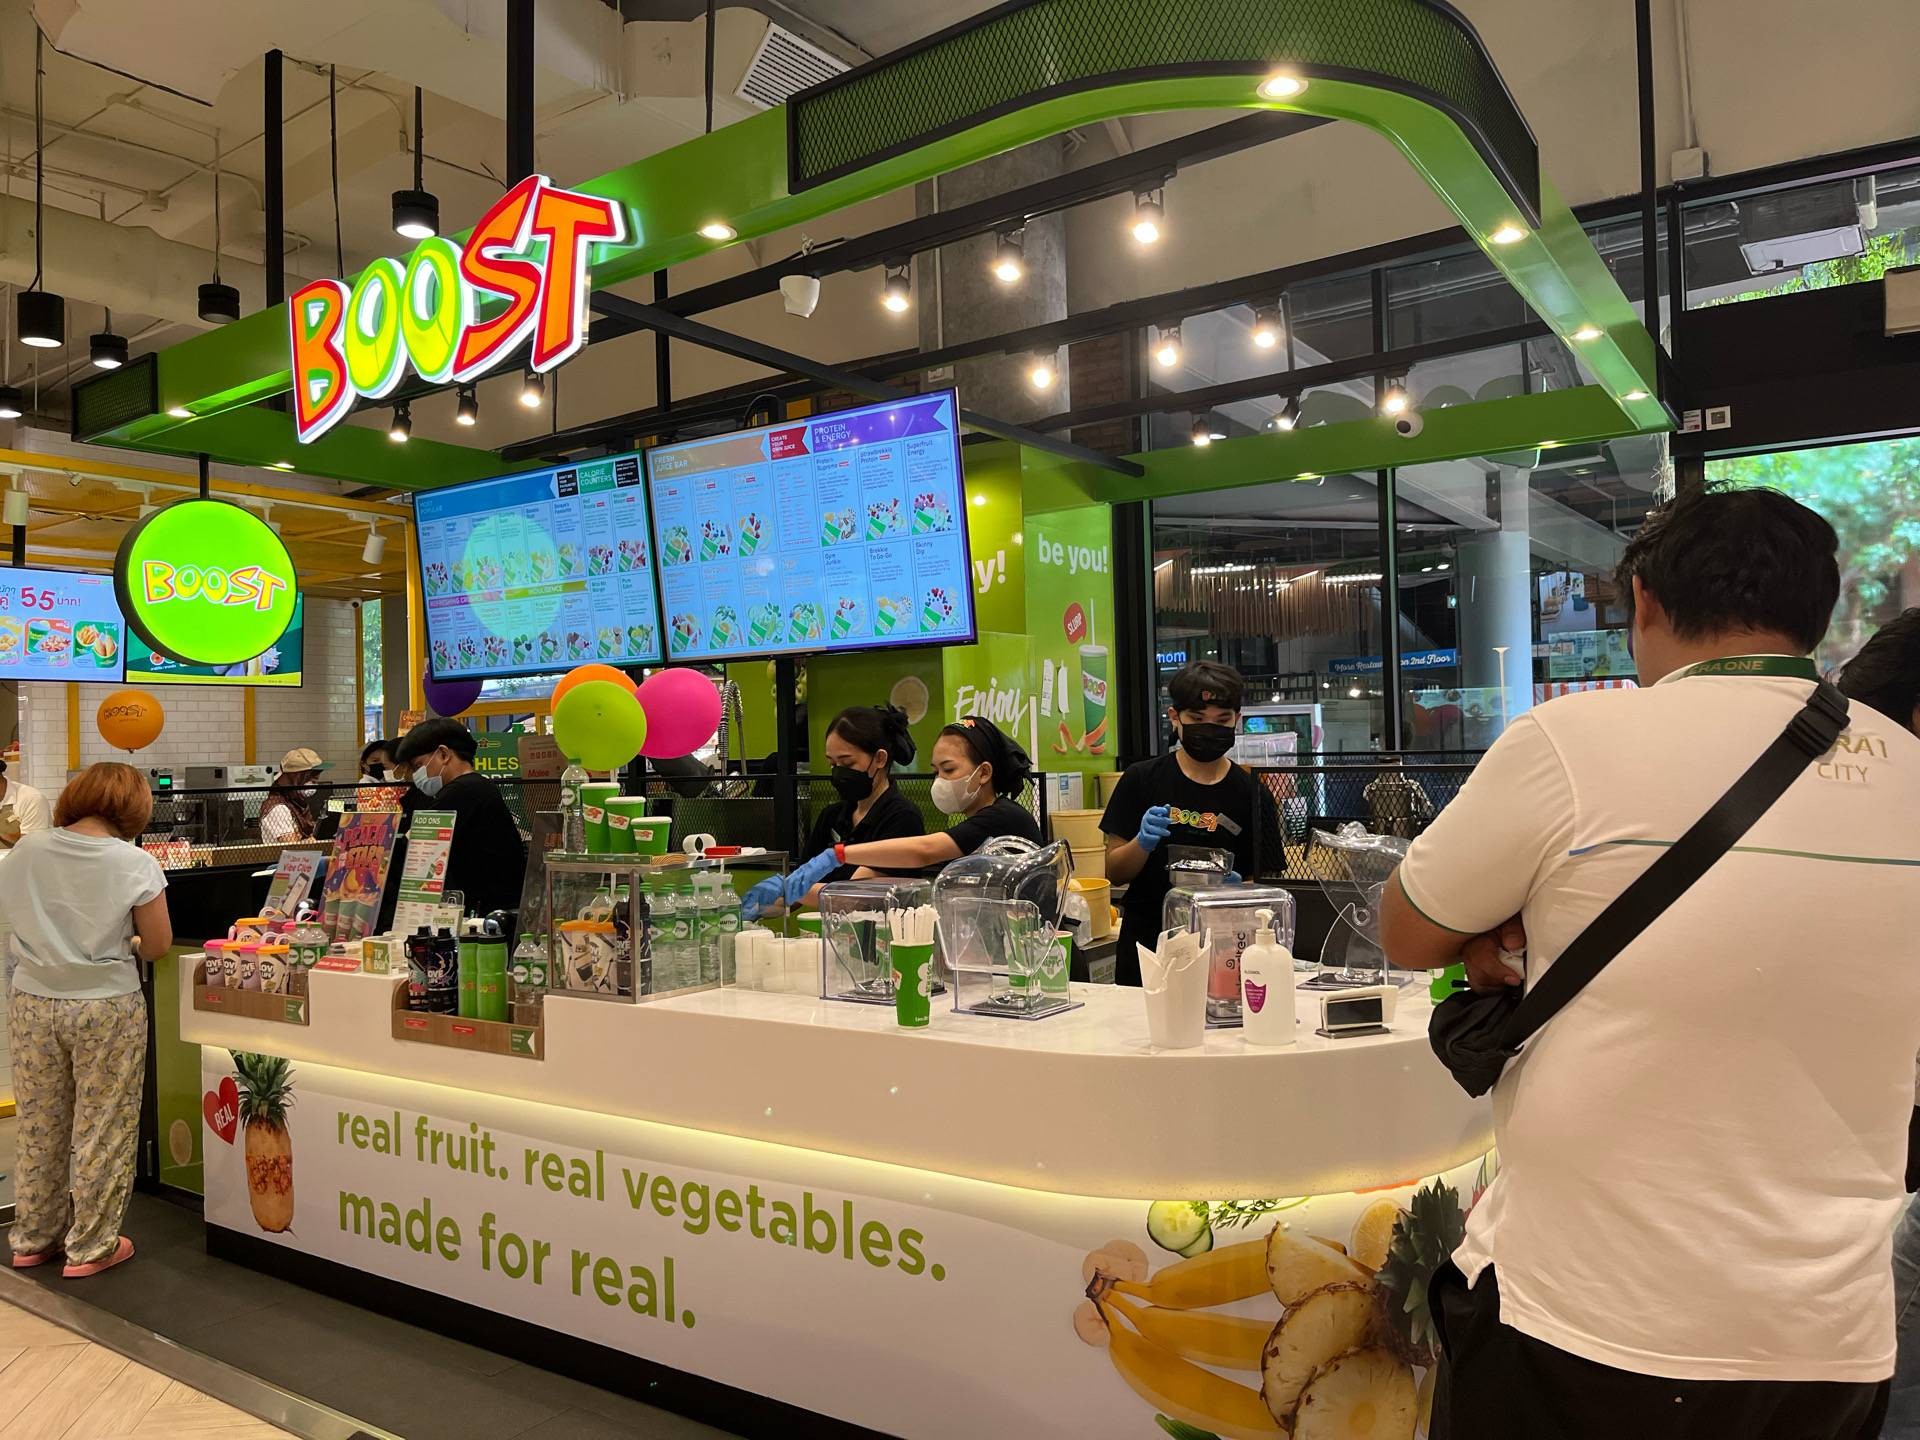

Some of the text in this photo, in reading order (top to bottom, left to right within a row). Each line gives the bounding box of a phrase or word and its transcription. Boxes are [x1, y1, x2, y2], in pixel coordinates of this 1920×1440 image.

[289, 174, 626, 444] BOOST
[814, 424, 846, 436] PROTEIN
[815, 430, 851, 444] & ENERGY
[580, 468, 605, 479] CALORIE
[580, 475, 612, 486] COUNTERS
[1038, 533, 1109, 576] be you!
[21, 586, 56, 611] 55
[143, 560, 287, 612] BOOST
[1410, 656, 1425, 665] 2nd
[1426, 654, 1451, 664] Floor
[1724, 660, 1764, 672] ONE
[953, 677, 1029, 738] Enjoy
[1817, 762, 1869, 784] CITY
[414, 817, 441, 825] ADD ONS
[1169, 806, 1218, 832] BOOST
[214, 1103, 236, 1132] REAL
[337, 1110, 946, 1282] real fruit. real vegetables.
[338, 1190, 697, 1328] made for real.
